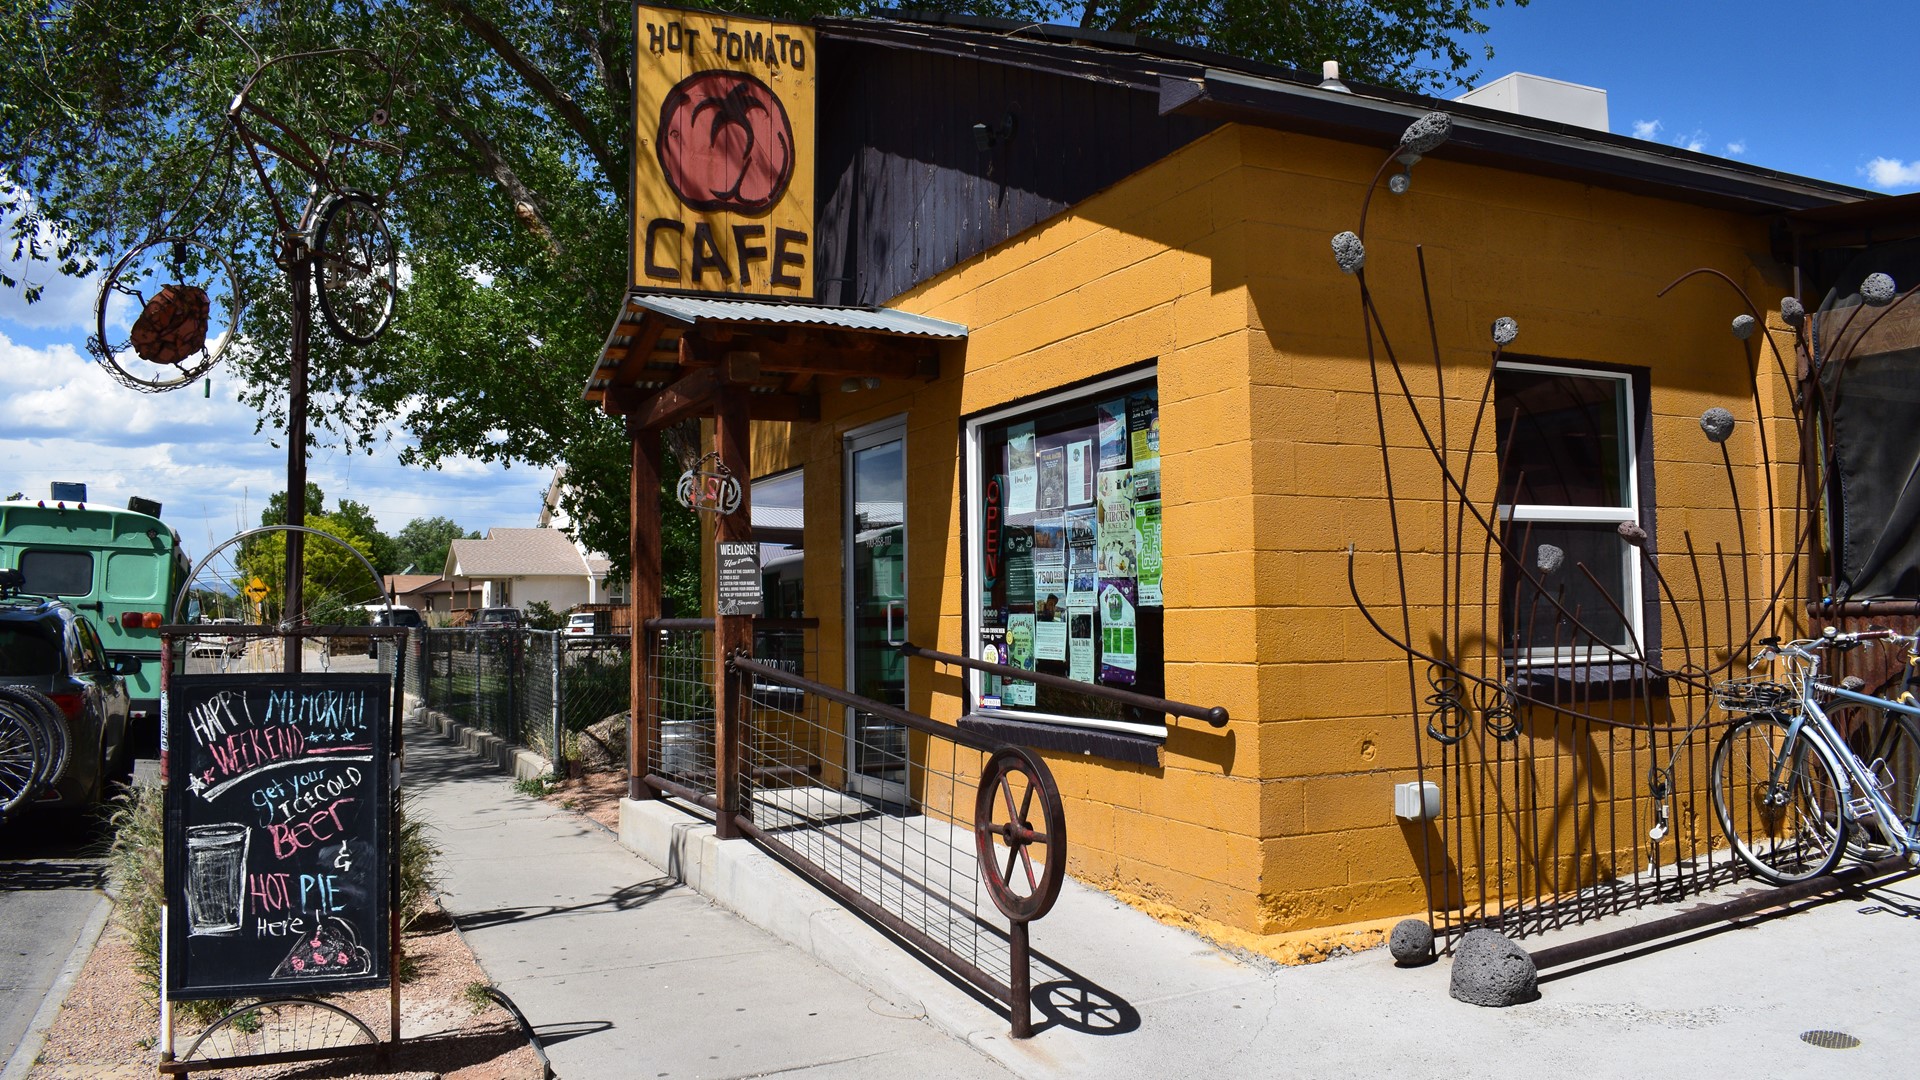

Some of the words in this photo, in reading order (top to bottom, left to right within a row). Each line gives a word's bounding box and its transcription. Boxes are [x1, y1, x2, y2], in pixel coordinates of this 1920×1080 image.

[646, 21, 700, 56] HOT
[711, 26, 805, 71] TOMATO
[644, 217, 809, 290] CAFE
[986, 481, 999, 578] OPEN
[1105, 511, 1130, 523] CIRCUS
[1108, 503, 1126, 511] SHRINE
[720, 544, 757, 555] WELCOME!
[1036, 570, 1053, 584] $7500
[188, 690, 255, 747] HAPPY
[264, 690, 367, 729] MEMORIAL
[208, 724, 305, 775] WEEKEND
[252, 779, 284, 829] get
[250, 873, 290, 915] HOT
[300, 873, 347, 915] PIE
